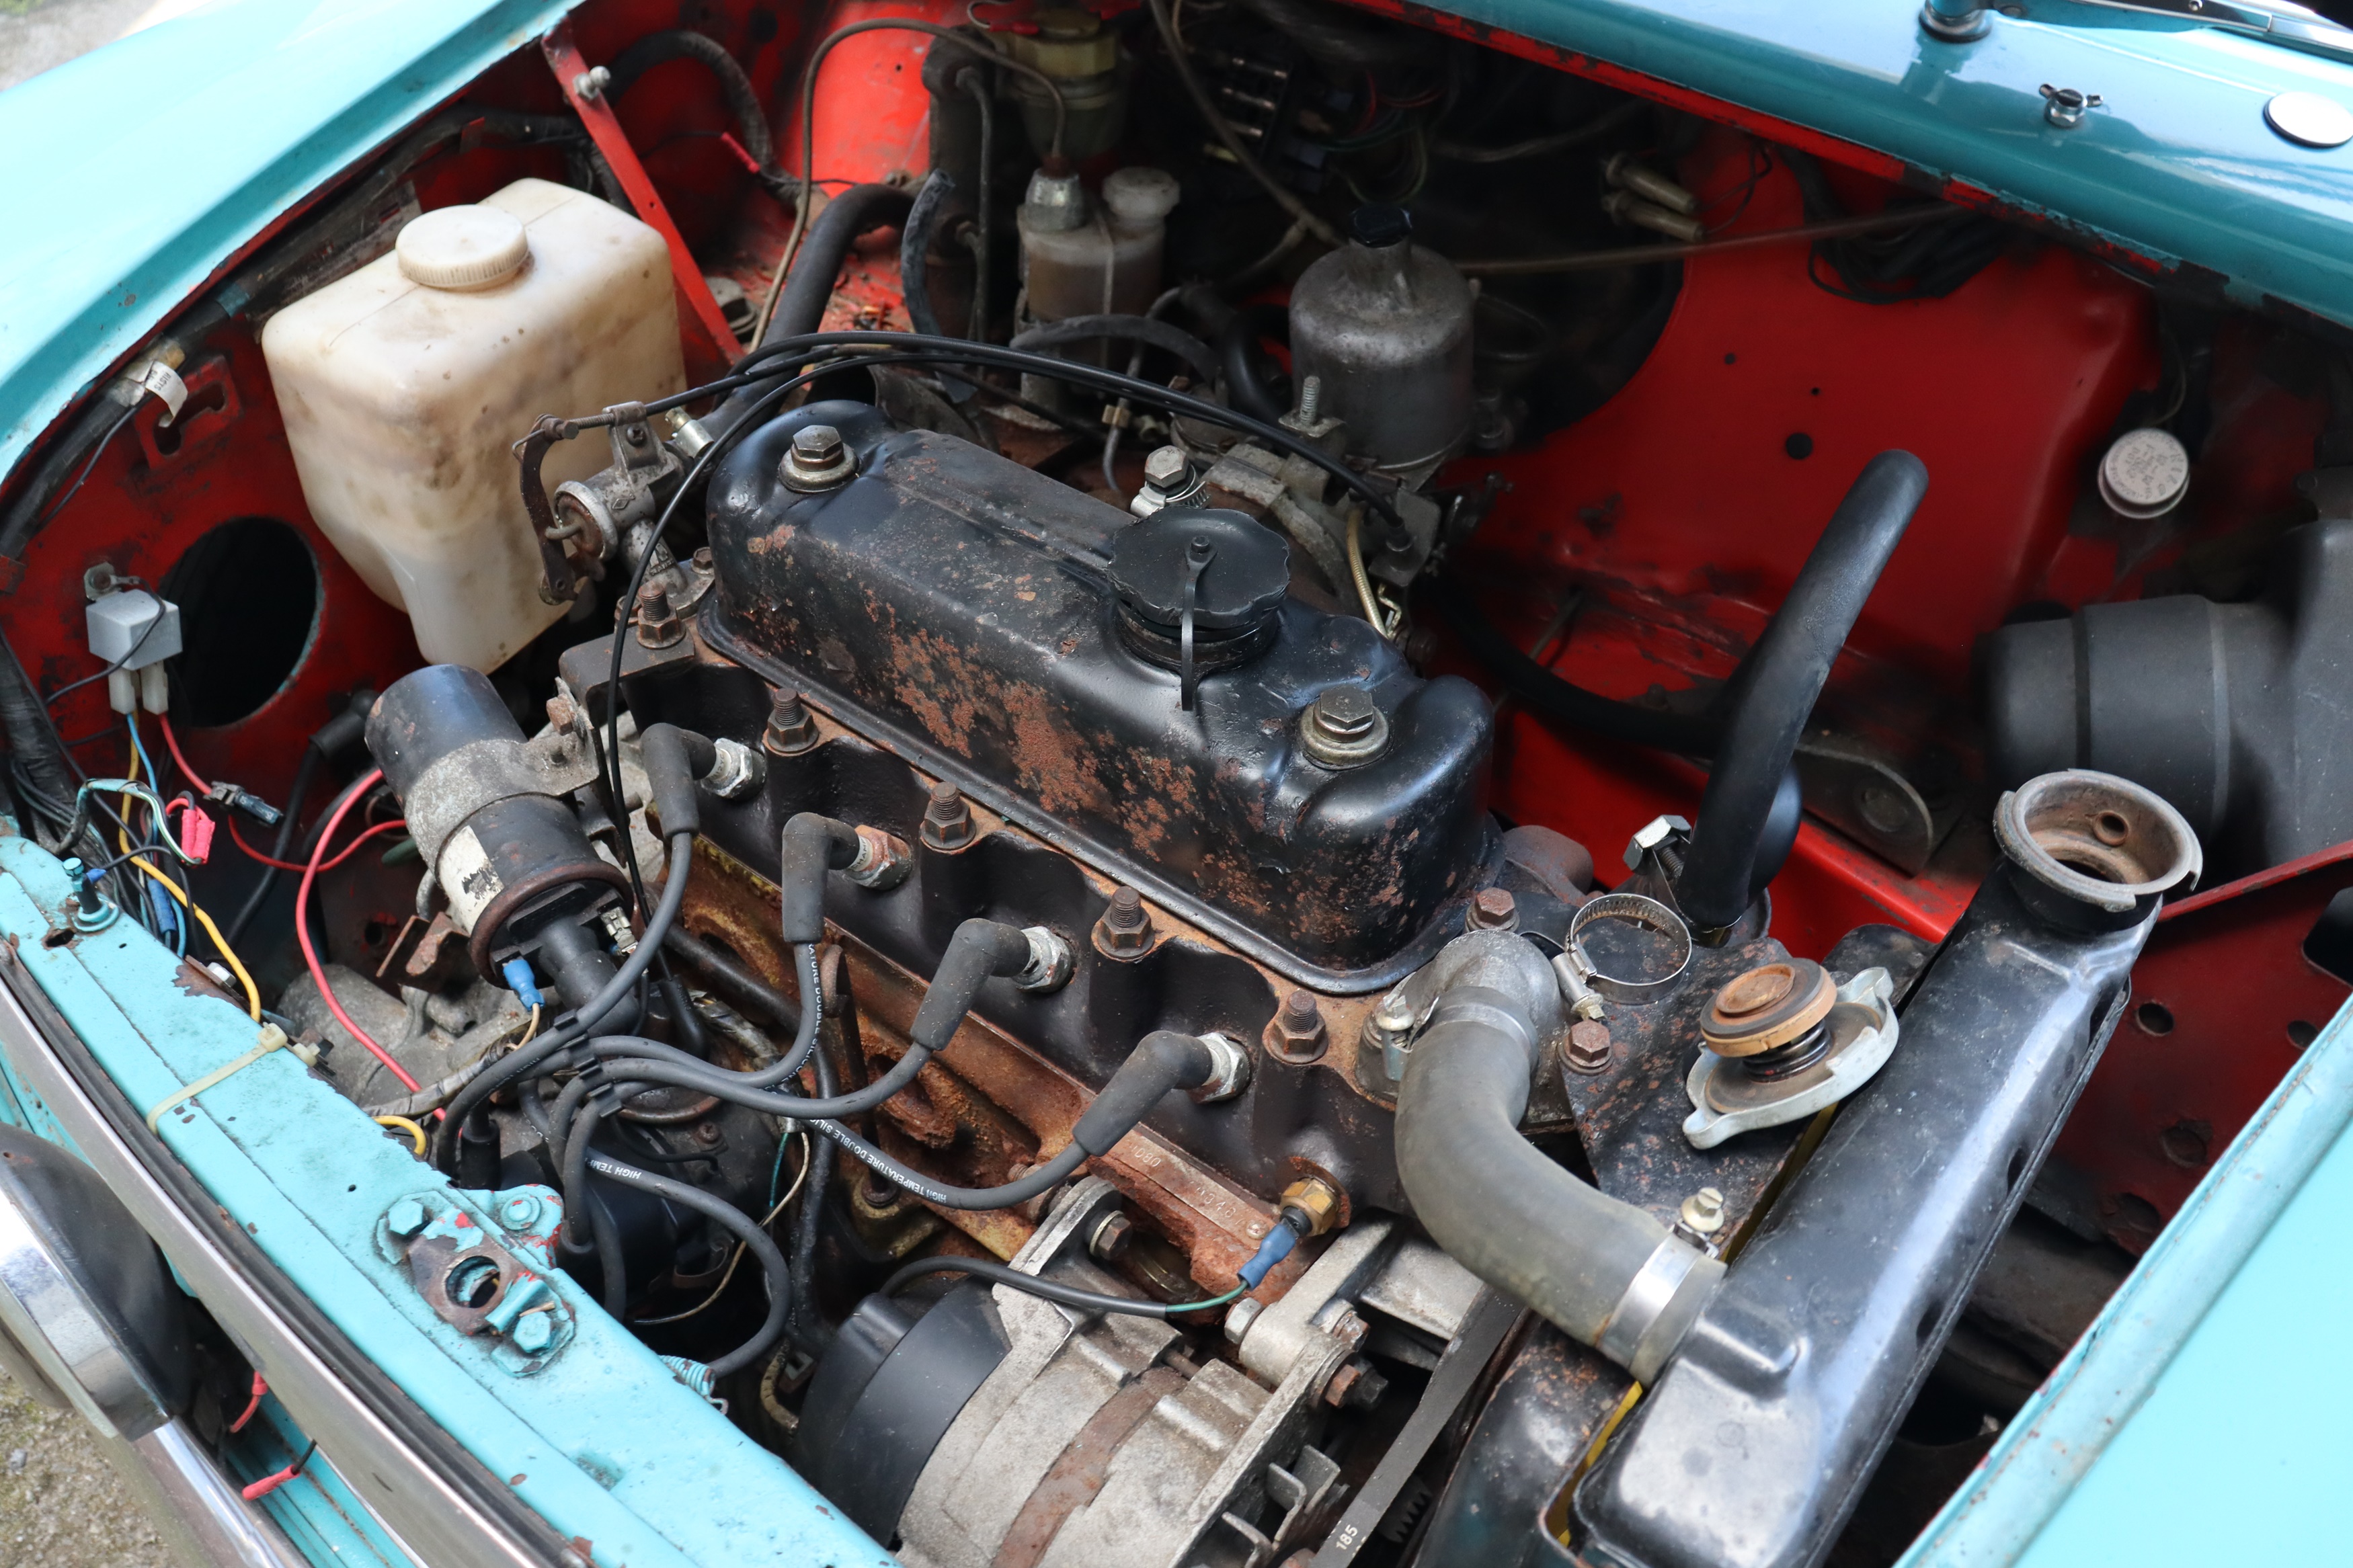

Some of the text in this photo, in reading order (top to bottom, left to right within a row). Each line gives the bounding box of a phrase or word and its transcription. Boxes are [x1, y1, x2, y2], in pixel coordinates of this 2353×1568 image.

[832, 1129, 868, 1159] DOUBLE
[614, 1167, 643, 1180] HIGH
[867, 1154, 925, 1196] TEMPERATURE
[1336, 1524, 1358, 1550] 185
